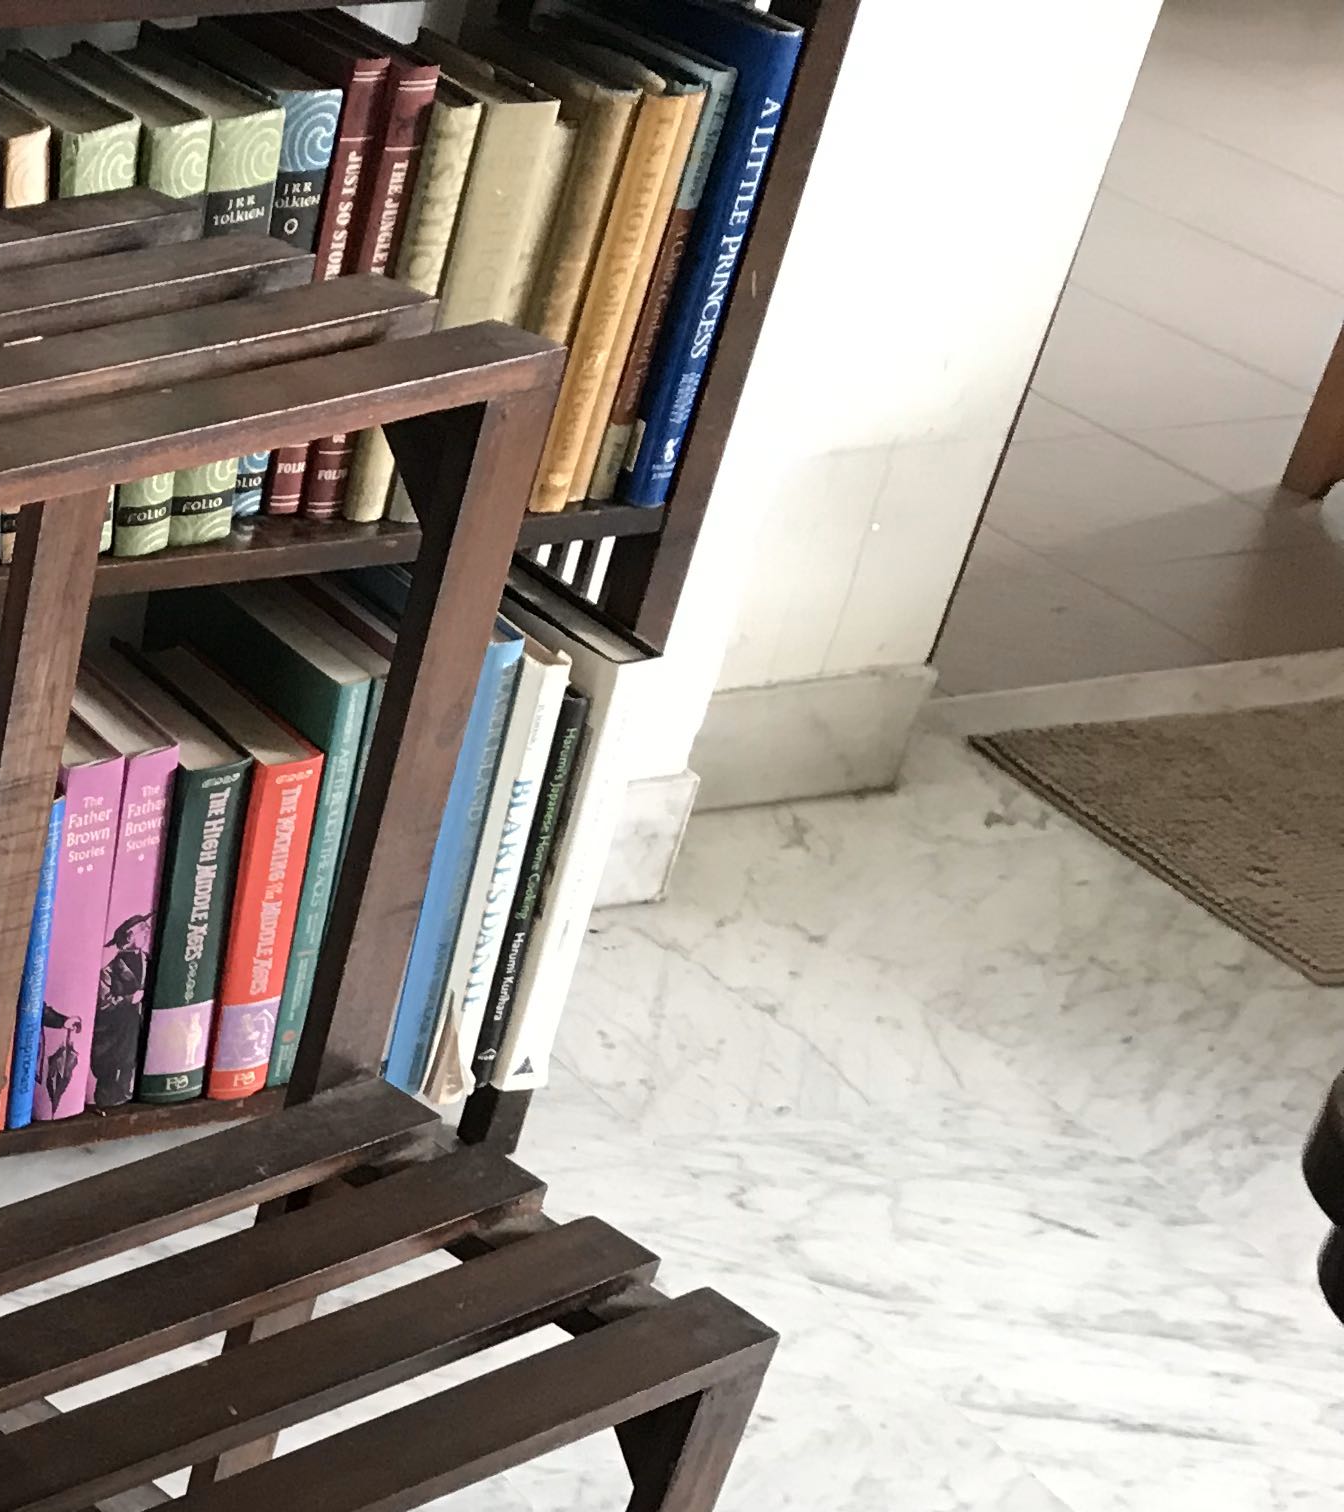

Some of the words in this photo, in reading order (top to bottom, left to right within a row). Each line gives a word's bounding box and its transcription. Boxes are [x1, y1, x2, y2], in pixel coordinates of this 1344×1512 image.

[761, 97, 781, 118] A
[341, 150, 363, 196] JUST
[387, 159, 409, 196] THE
[729, 126, 775, 226] LITTLE
[275, 194, 321, 208] OLKIEN
[336, 200, 354, 227] SO
[372, 197, 400, 265] JUNGLE
[691, 233, 743, 358] PRINCESS
[235, 476, 262, 489] OLIO
[127, 505, 167, 522] FOLIO
[182, 496, 223, 513] FOLIO
[554, 728, 577, 780] Harumi's
[83, 796, 103, 808] The
[141, 785, 160, 797] The
[208, 787, 231, 817] THE
[280, 784, 302, 814] THE
[542, 781, 563, 832] Japanese
[68, 808, 112, 829] Father
[125, 816, 164, 836] Brown
[66, 827, 110, 847] Brown
[68, 846, 105, 863] Stories
[126, 835, 160, 852] Stories
[199, 818, 226, 863] HIGH
[531, 835, 552, 870] Home
[190, 864, 217, 922] MIDDLE
[514, 873, 540, 920] Cooking
[185, 923, 208, 962] AGES
[255, 900, 282, 957] MIDDLE
[506, 932, 525, 974] Harumi
[250, 957, 273, 995] AGES
[494, 976, 514, 1020] Kurihara
